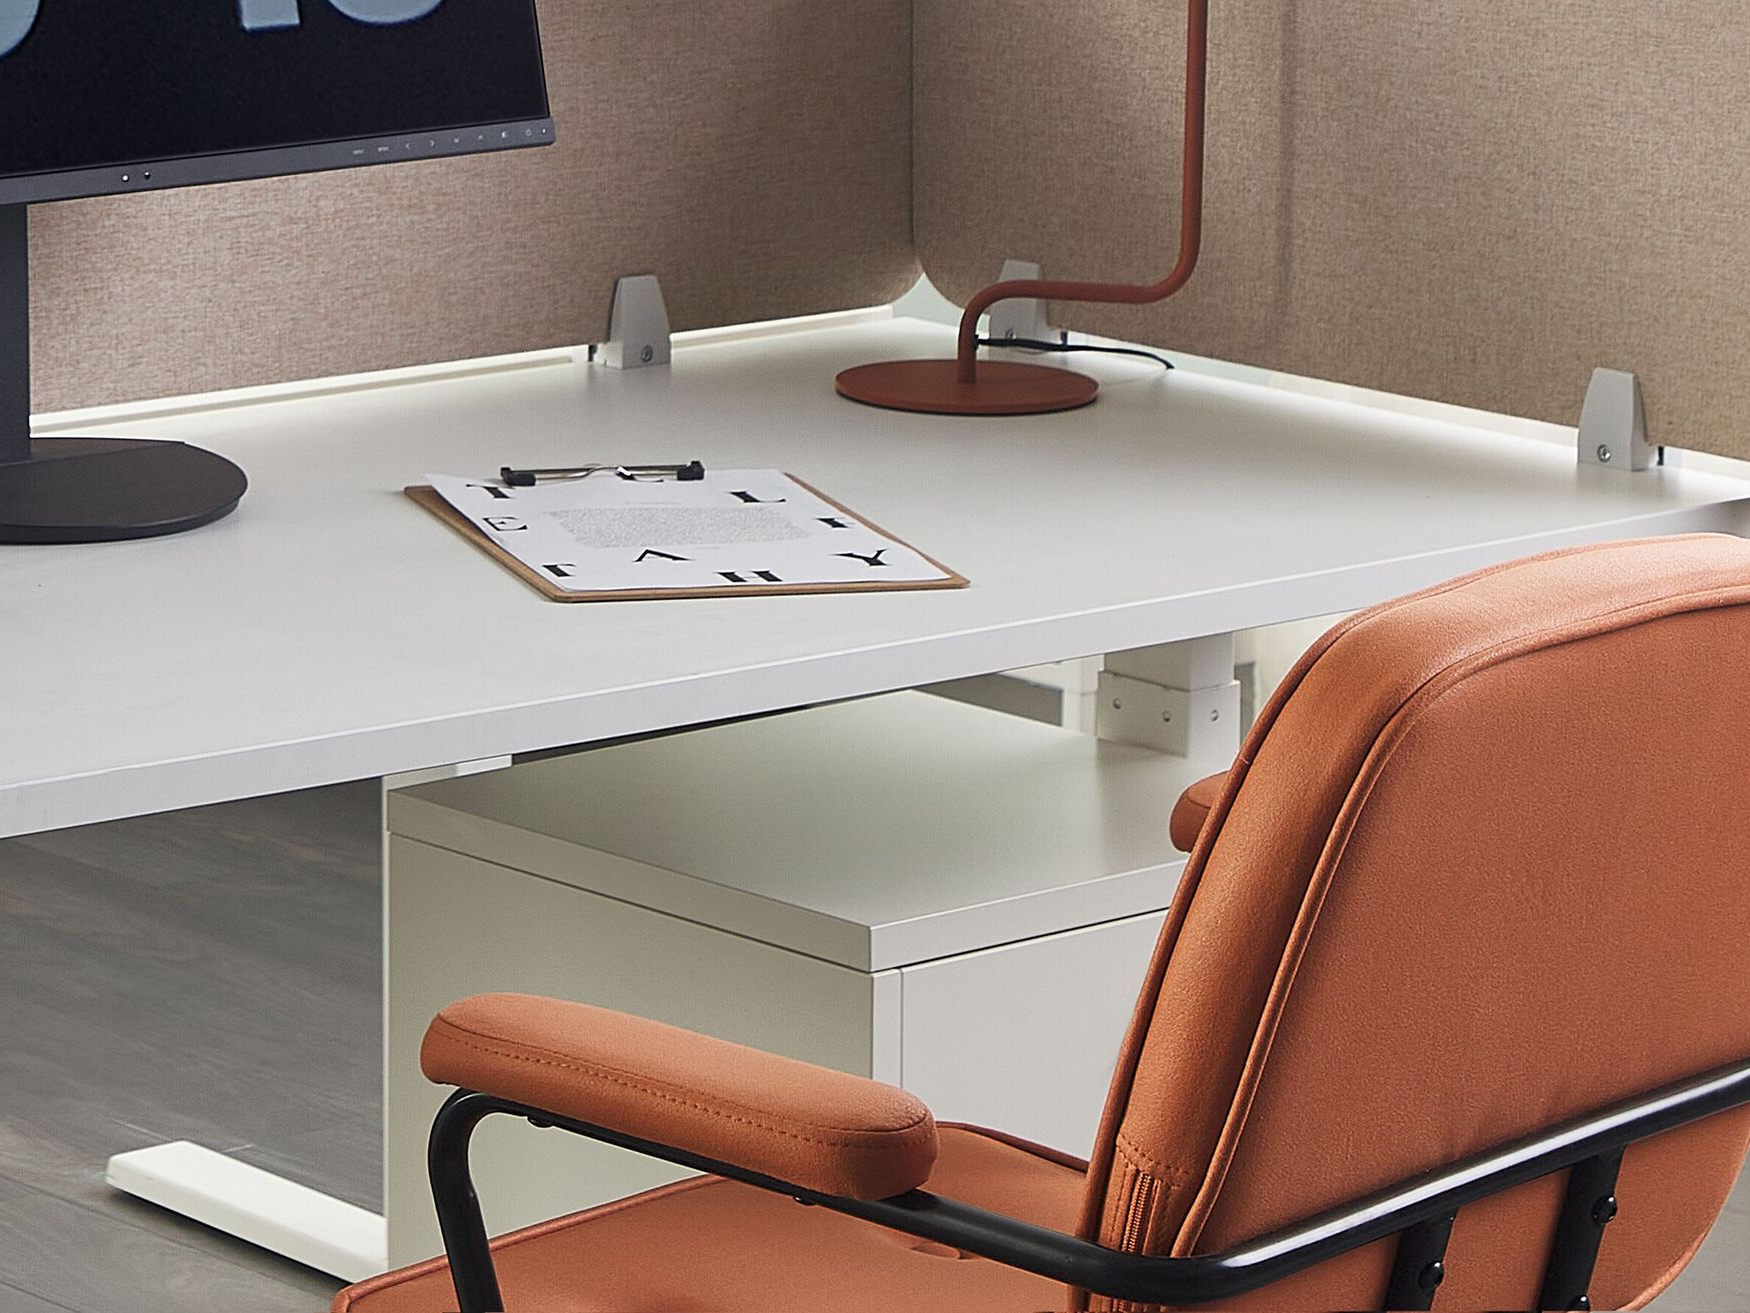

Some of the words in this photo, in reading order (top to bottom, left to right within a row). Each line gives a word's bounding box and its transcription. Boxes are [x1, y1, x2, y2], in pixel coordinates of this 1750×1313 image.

[728, 491, 786, 503] L
[482, 516, 528, 532] E
[632, 548, 691, 563] A
[829, 548, 889, 567] Y
[713, 570, 783, 583] H
